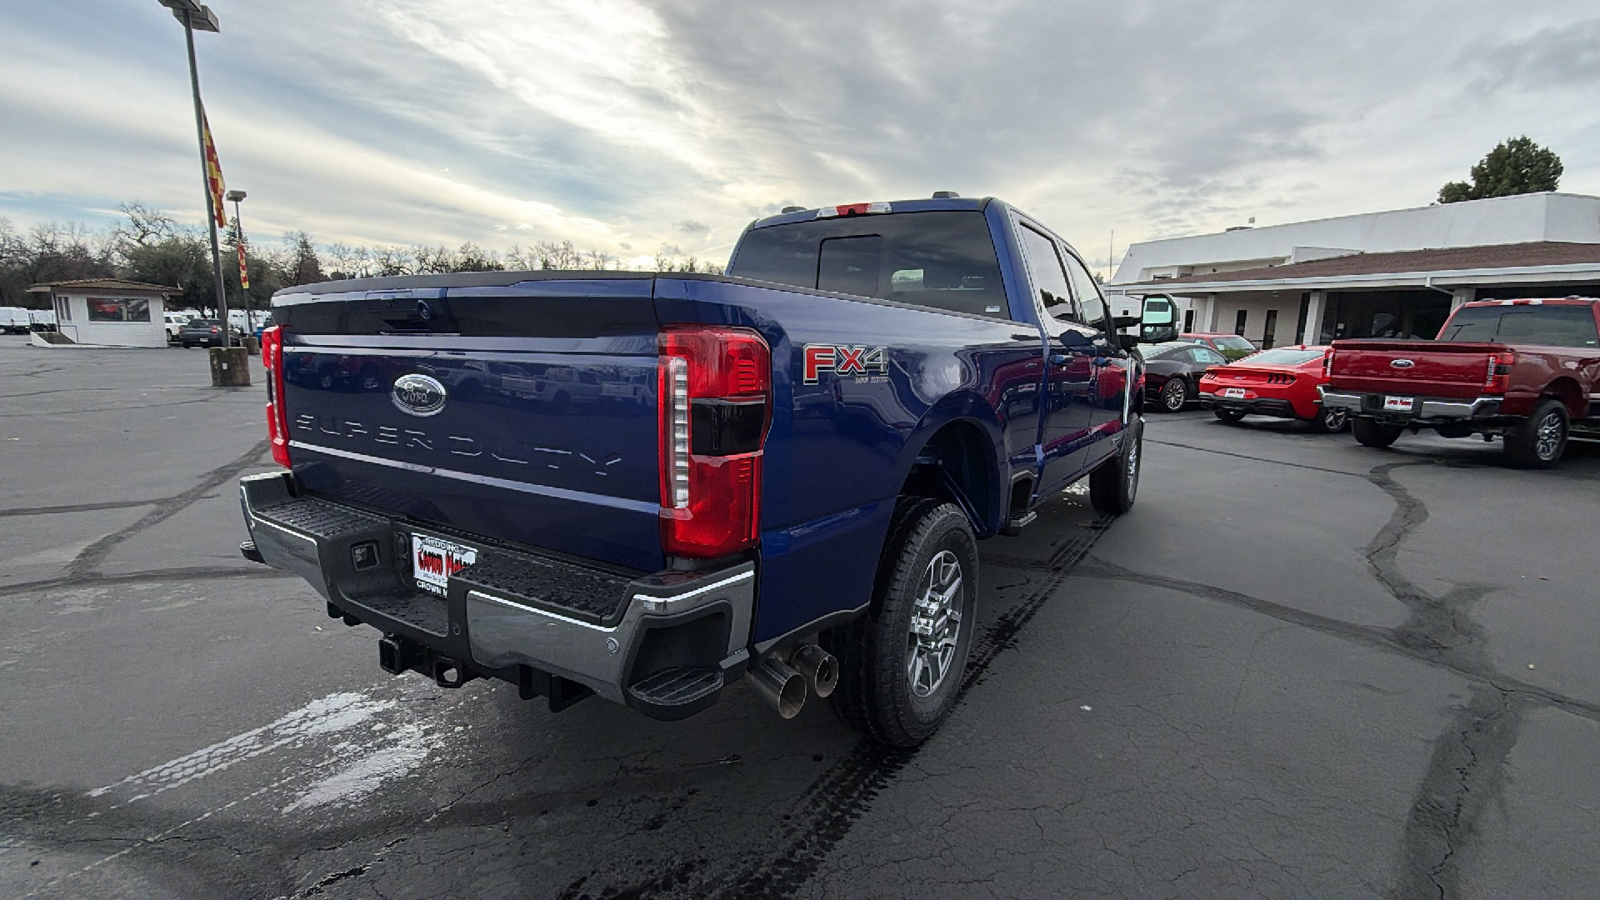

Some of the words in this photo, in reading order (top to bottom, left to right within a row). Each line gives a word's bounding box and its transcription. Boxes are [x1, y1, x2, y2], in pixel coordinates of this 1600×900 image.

[803, 343, 888, 385] FX4
[296, 414, 434, 450] SUPER
[449, 436, 622, 476] DUTY
[425, 537, 460, 553] REDDING
[417, 548, 443, 576] Crown
[416, 580, 442, 595] CROWN
